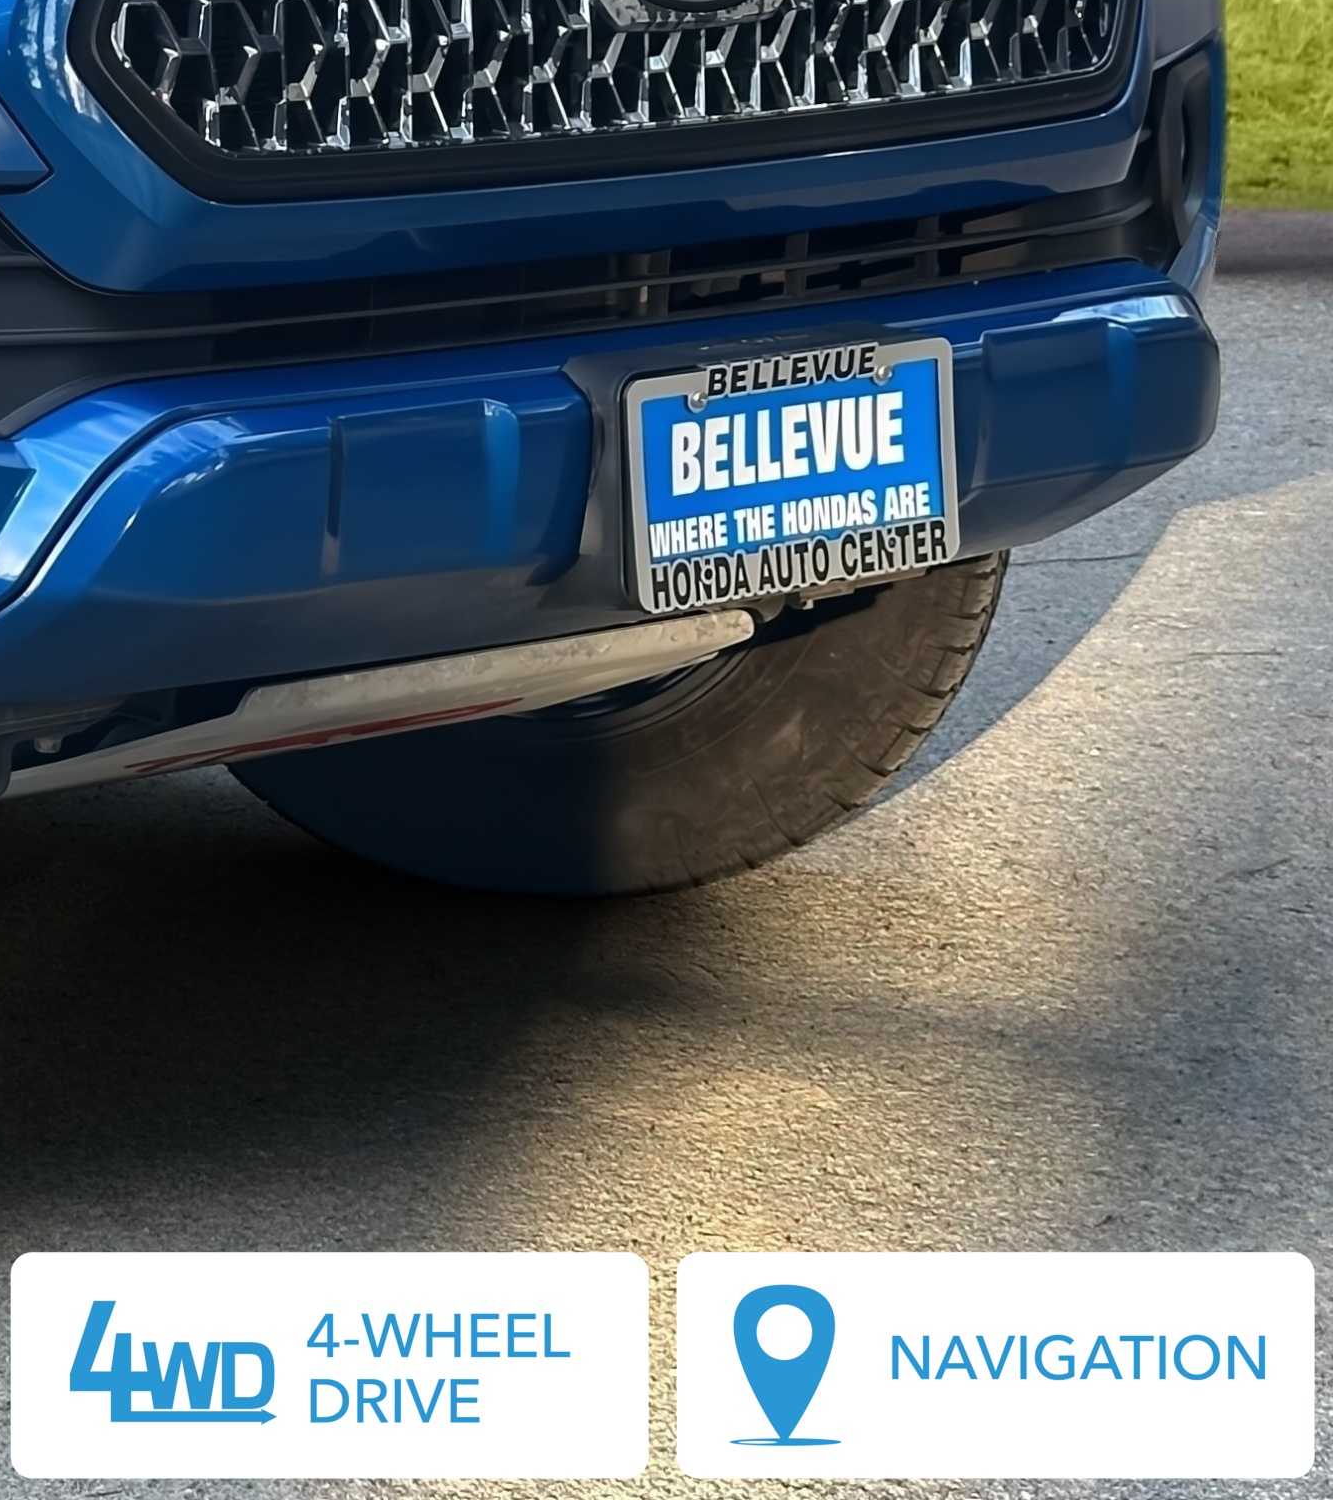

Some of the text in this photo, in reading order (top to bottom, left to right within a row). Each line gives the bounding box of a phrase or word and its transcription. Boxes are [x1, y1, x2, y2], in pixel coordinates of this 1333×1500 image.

[707, 346, 876, 396] BELLEVUE
[671, 391, 904, 497] BELLEVUE
[649, 481, 931, 558] WHERE THE HONDAS ARE
[651, 520, 948, 610] HONDA AUTO CENTER
